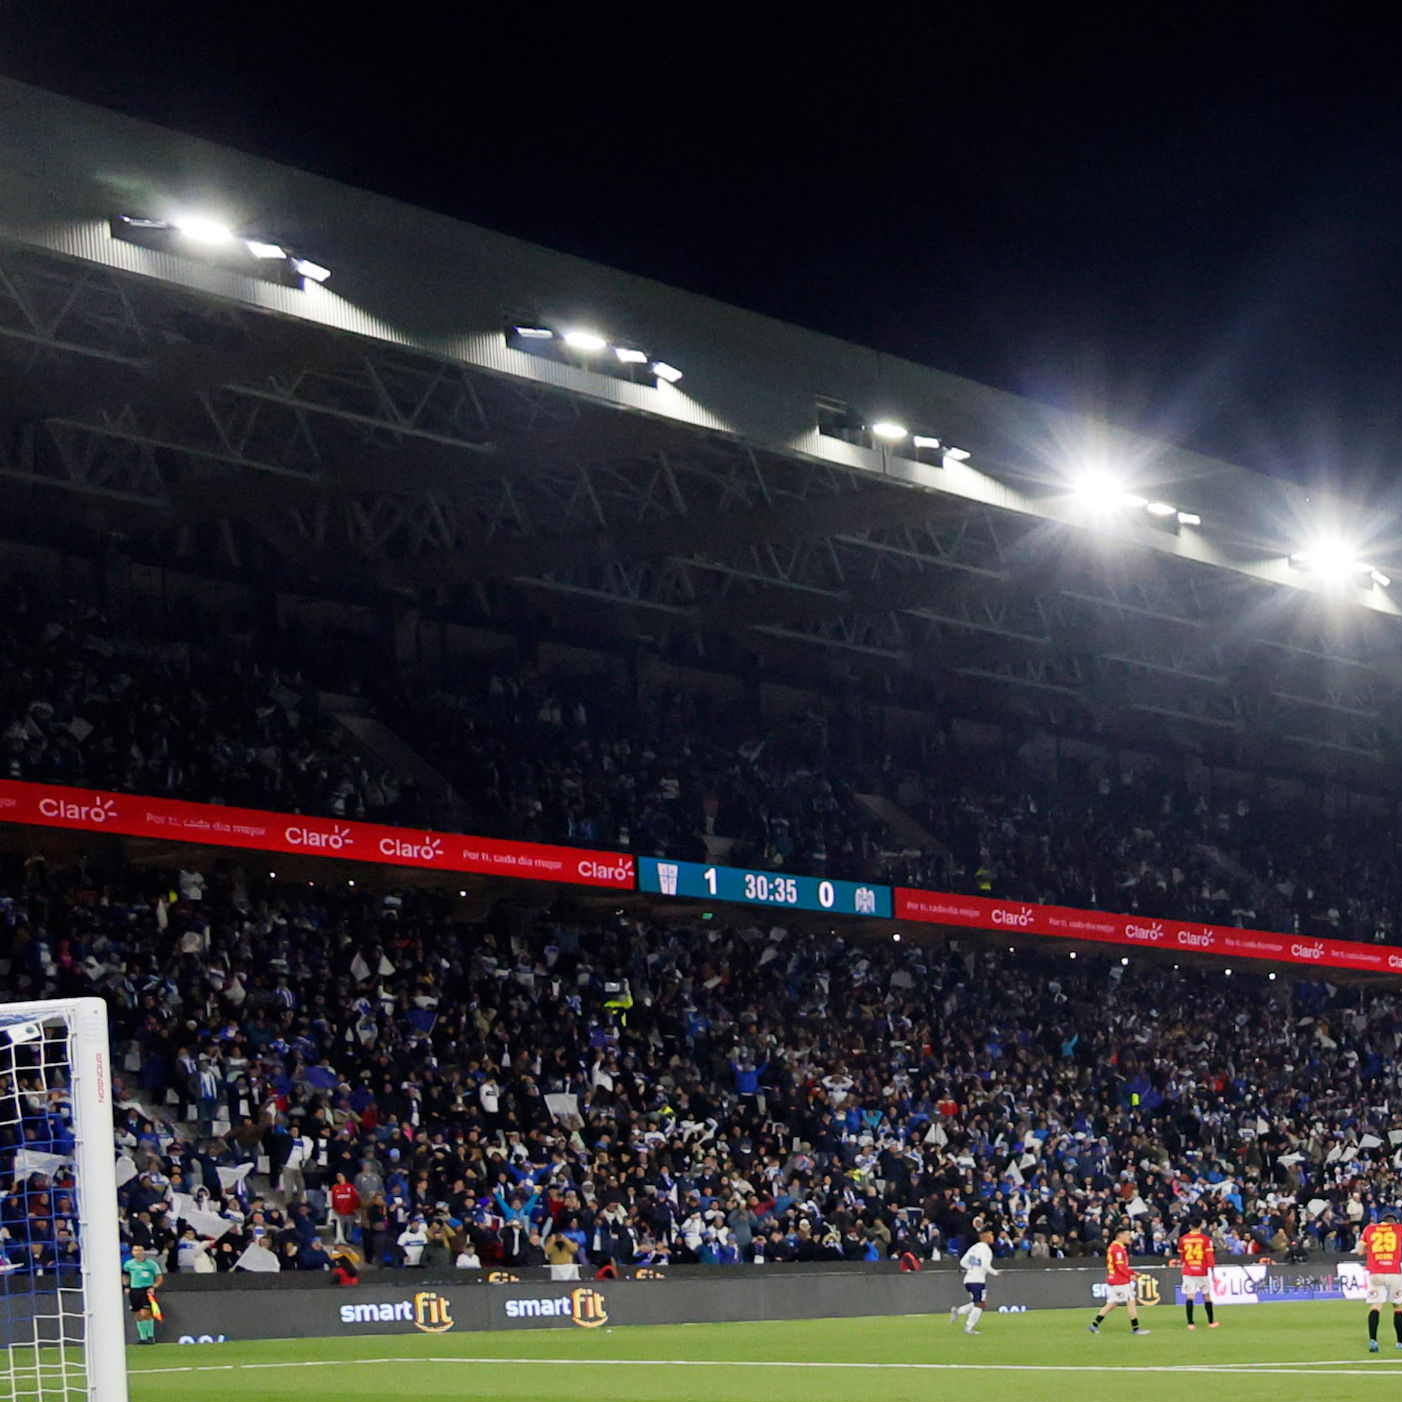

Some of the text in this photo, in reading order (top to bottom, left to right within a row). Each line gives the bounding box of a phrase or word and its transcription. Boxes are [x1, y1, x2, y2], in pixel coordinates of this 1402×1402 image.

[39, 797, 114, 822] Claro
[285, 825, 352, 849] Claro
[380, 836, 442, 860] Claro
[578, 859, 634, 880] Claro
[704, 868, 717, 895] 1
[745, 874, 797, 904] 30:35
[818, 881, 835, 908] 0
[991, 907, 1033, 926] Claro
[1125, 923, 1163, 940] Claro
[1178, 929, 1214, 946] Claro
[1291, 942, 1324, 959] Claro
[1184, 1243, 1204, 1260] 24
[1370, 1231, 1397, 1253] 29
